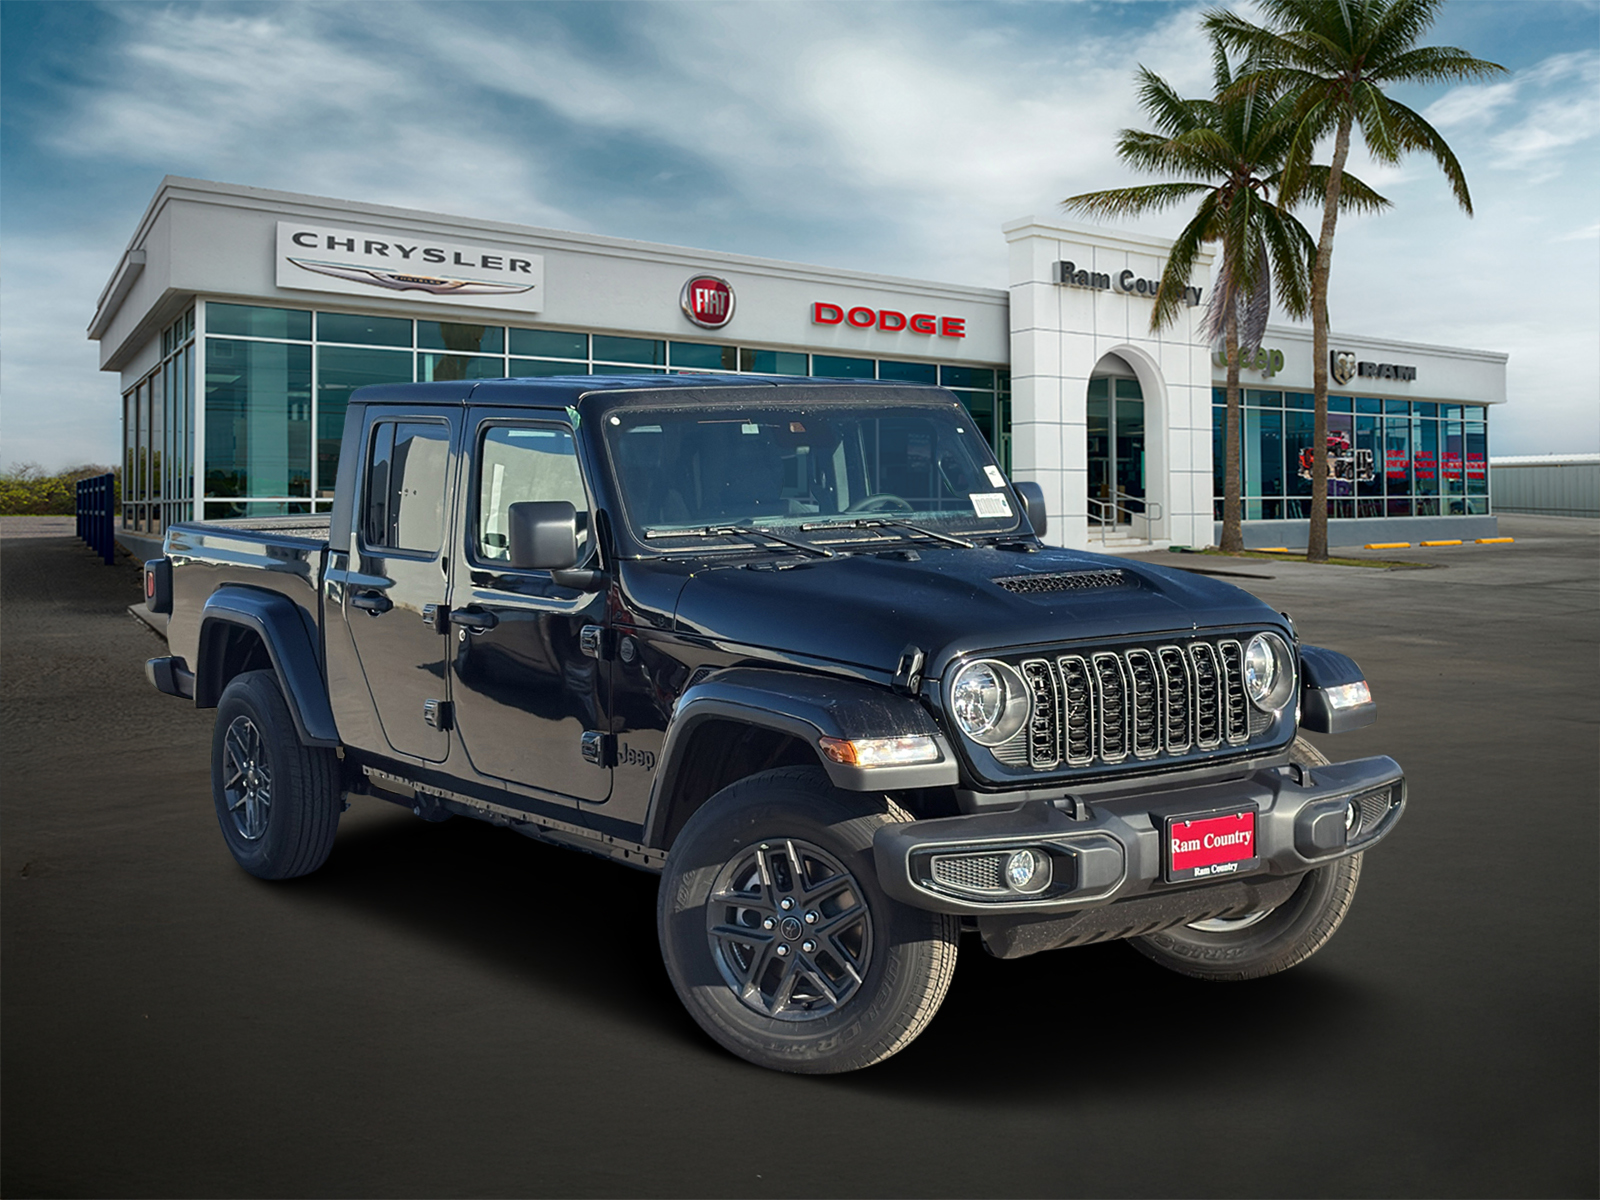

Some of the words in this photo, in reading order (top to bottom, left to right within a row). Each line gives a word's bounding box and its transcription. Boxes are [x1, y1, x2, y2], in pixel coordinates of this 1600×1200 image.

[292, 231, 532, 273] CHRYSLER
[1054, 260, 1110, 290] Ram
[1117, 269, 1203, 306] Coury
[695, 288, 727, 316] FIAT
[812, 301, 966, 338] DODGE
[1358, 361, 1417, 381] RAM
[617, 742, 655, 771] Jeep
[1171, 838, 1201, 854] Ram
[1203, 830, 1252, 849] Country
[1194, 866, 1210, 877] Ram
[1211, 862, 1238, 874] Country
